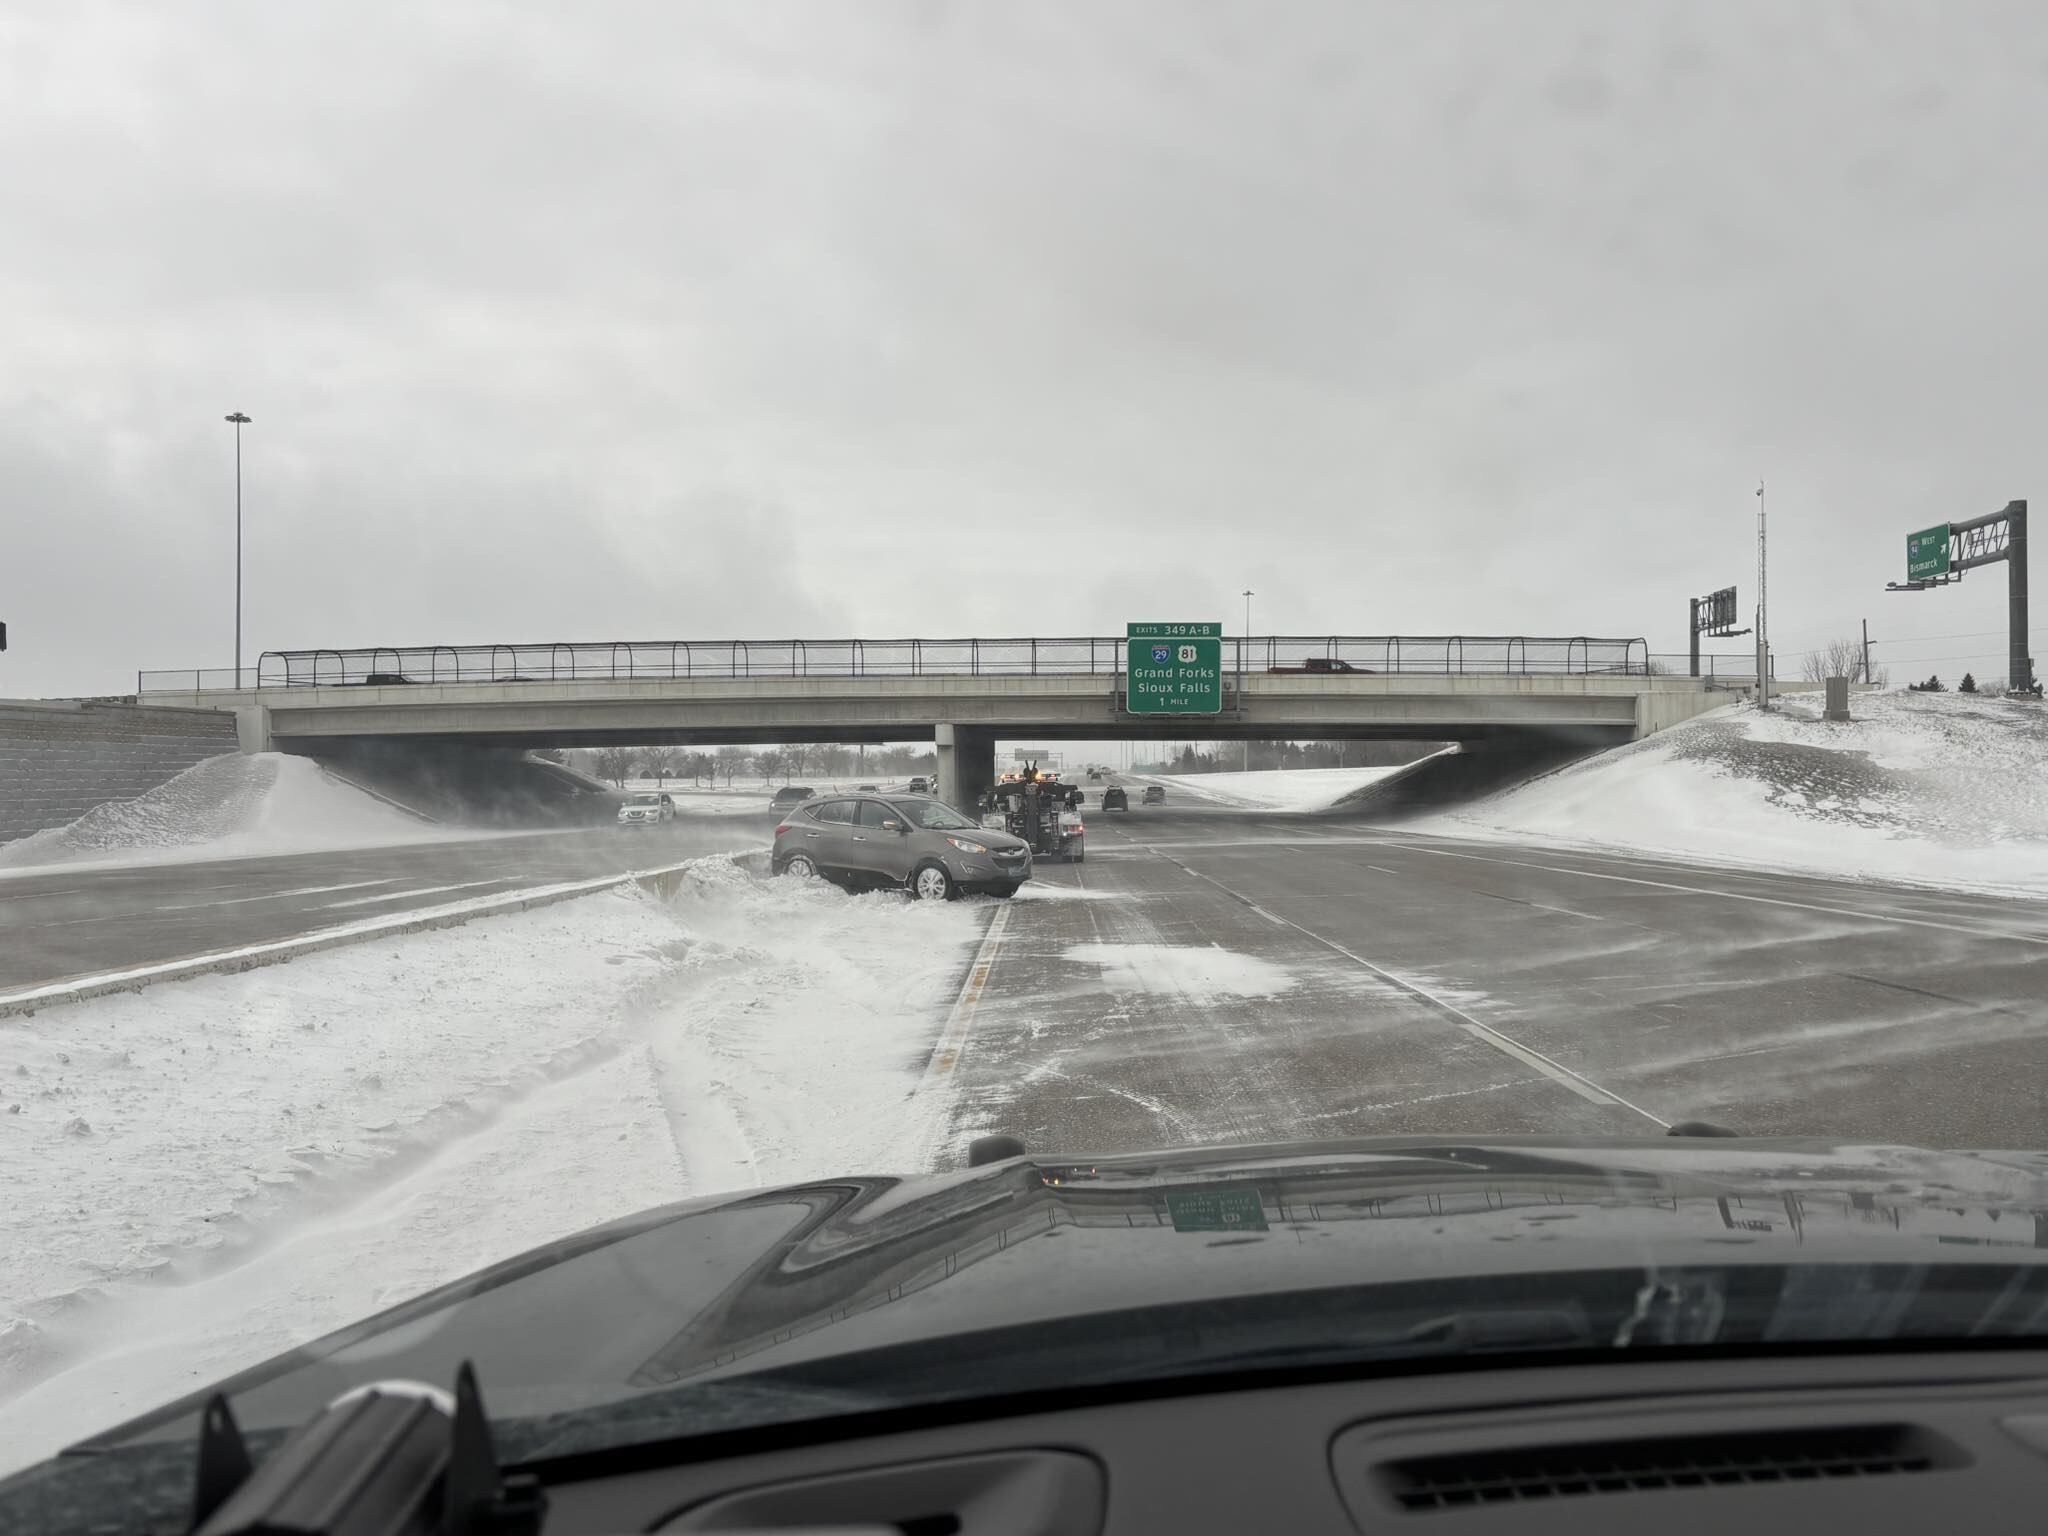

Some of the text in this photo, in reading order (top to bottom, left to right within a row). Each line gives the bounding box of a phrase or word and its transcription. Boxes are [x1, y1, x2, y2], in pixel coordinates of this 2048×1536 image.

[1922, 536, 1935, 545] WEST
[1910, 558, 1938, 573] Bismarck
[1136, 625, 1210, 635] EXITS 349 A-B
[1155, 650, 1167, 660] 29
[1182, 649, 1194, 659] 81
[1134, 667, 1214, 678] Grand Forks
[1138, 682, 1211, 693] Sioux Falls
[1160, 697, 1165, 706] 1
